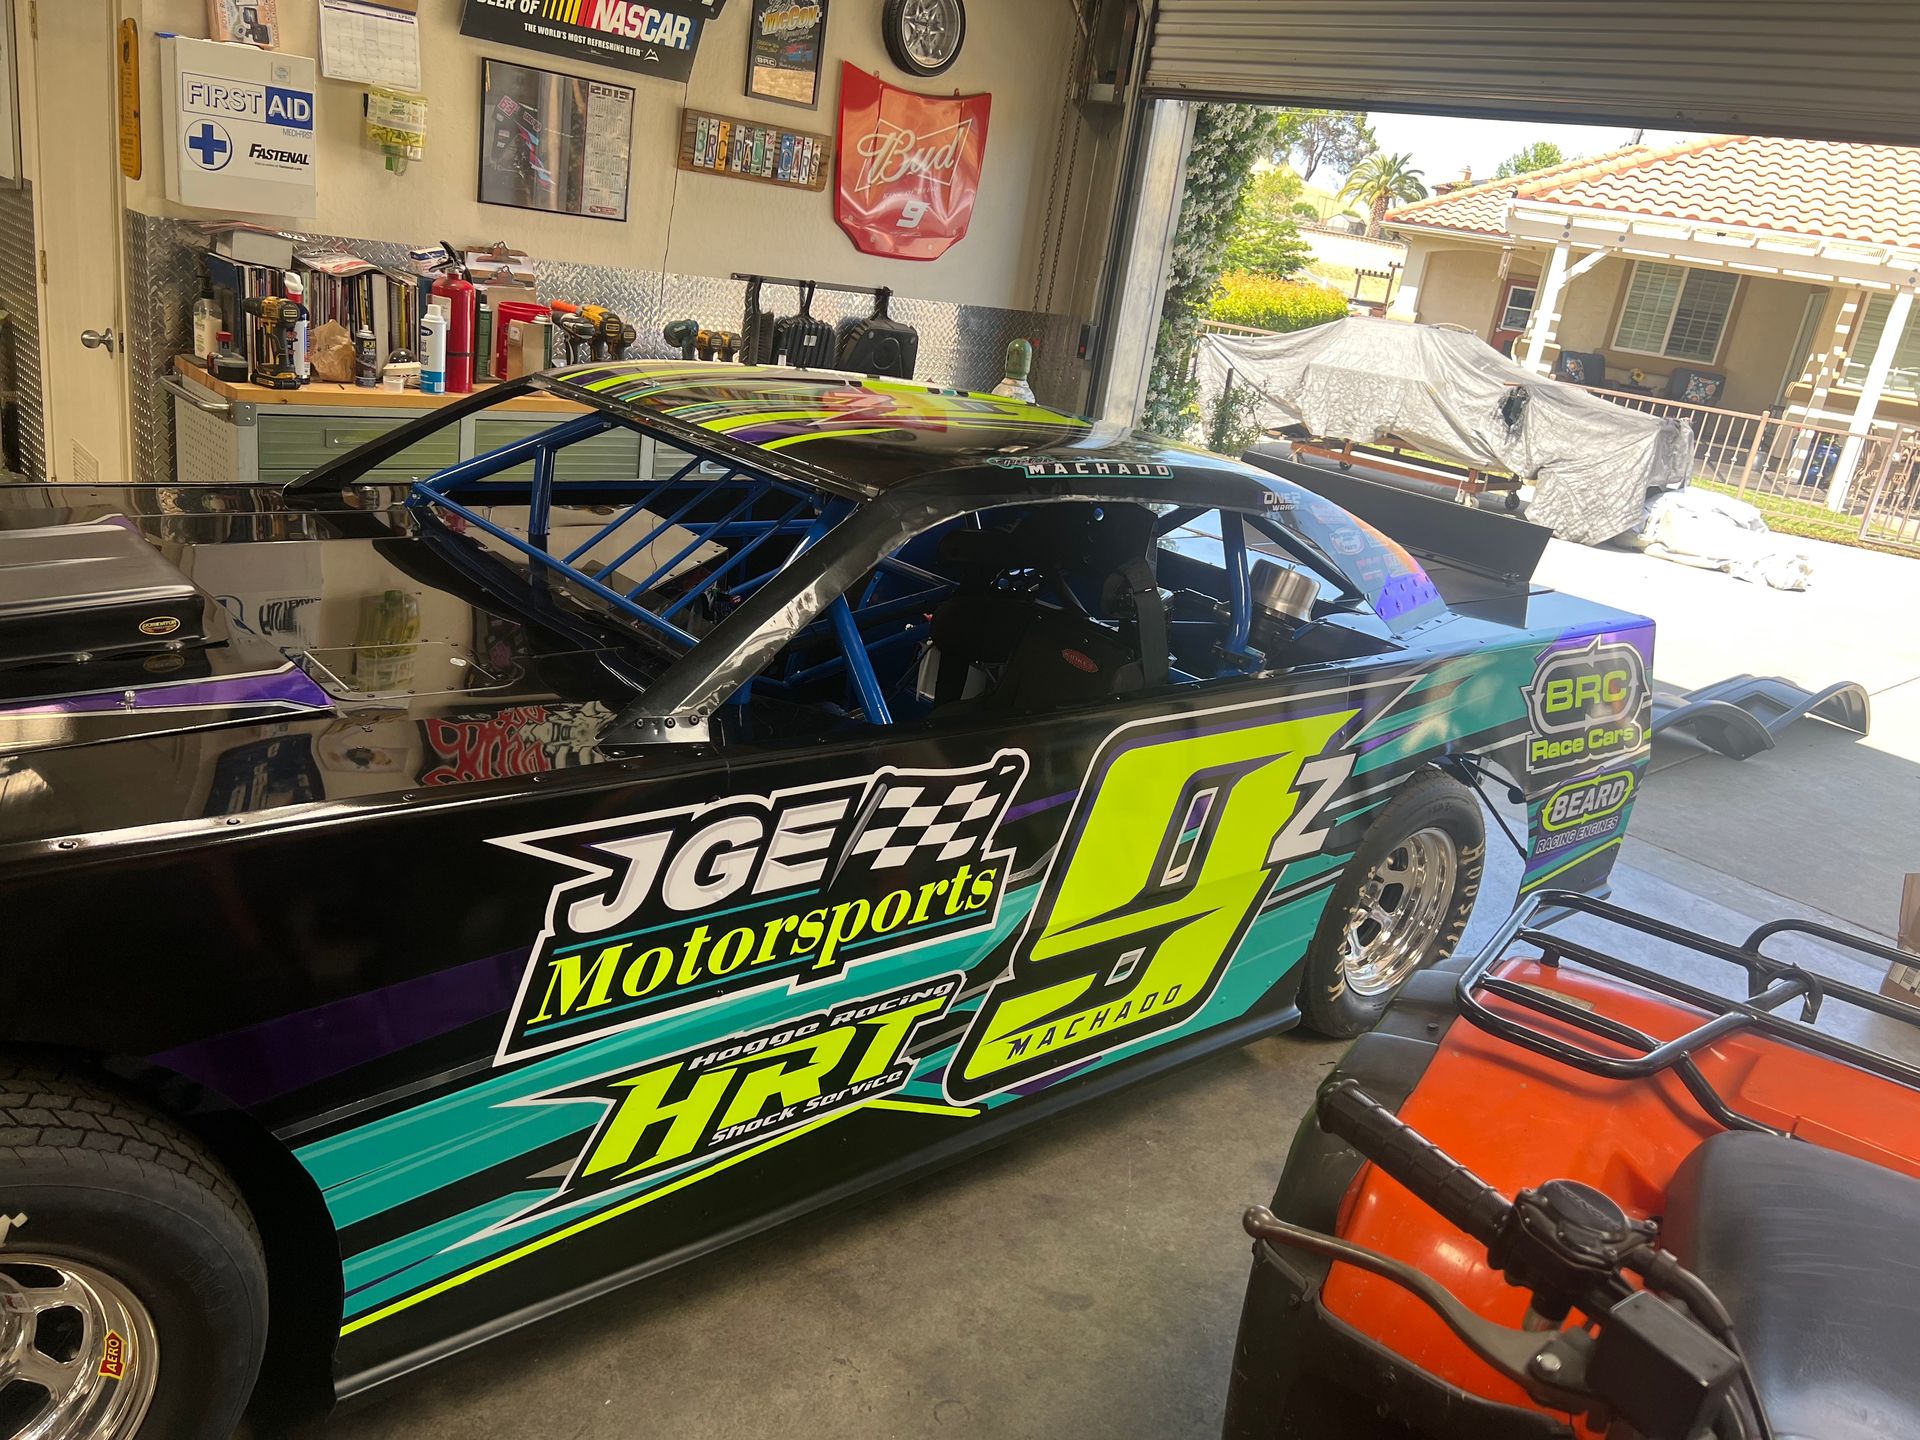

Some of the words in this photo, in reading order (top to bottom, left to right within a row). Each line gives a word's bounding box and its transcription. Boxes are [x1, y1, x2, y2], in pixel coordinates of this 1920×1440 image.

[524, 22, 537, 32] THE
[537, 25, 567, 40] WORLD'S
[567, 32, 586, 45] MOST
[587, 38, 625, 53] REFRESHING
[625, 46, 641, 57] BEER
[592, 0, 691, 49] NASCAR
[187, 80, 262, 114] FIRST
[268, 94, 311, 122] AID
[590, 85, 630, 100] 2015
[248, 143, 310, 165] FASTENAL
[856, 129, 965, 184] Bud
[896, 200, 931, 229] 9
[1029, 463, 1170, 476] MACHADO
[1546, 670, 1627, 713] BRC
[1532, 738, 1585, 762] Race
[1588, 726, 1634, 749] Cars
[1550, 780, 1626, 823] BEARD
[1536, 828, 1577, 854] RACING
[1577, 815, 1619, 842] ENGINES
[567, 798, 850, 934] JGE
[964, 708, 1362, 1080] 9
[527, 862, 999, 1026] Motorsports
[1005, 983, 1182, 1061] MACHADO
[580, 995, 948, 1180] HRT
[707, 1106, 796, 1148] Shock
[803, 1069, 904, 1116] Service
[106, 1339, 120, 1373] AERO
